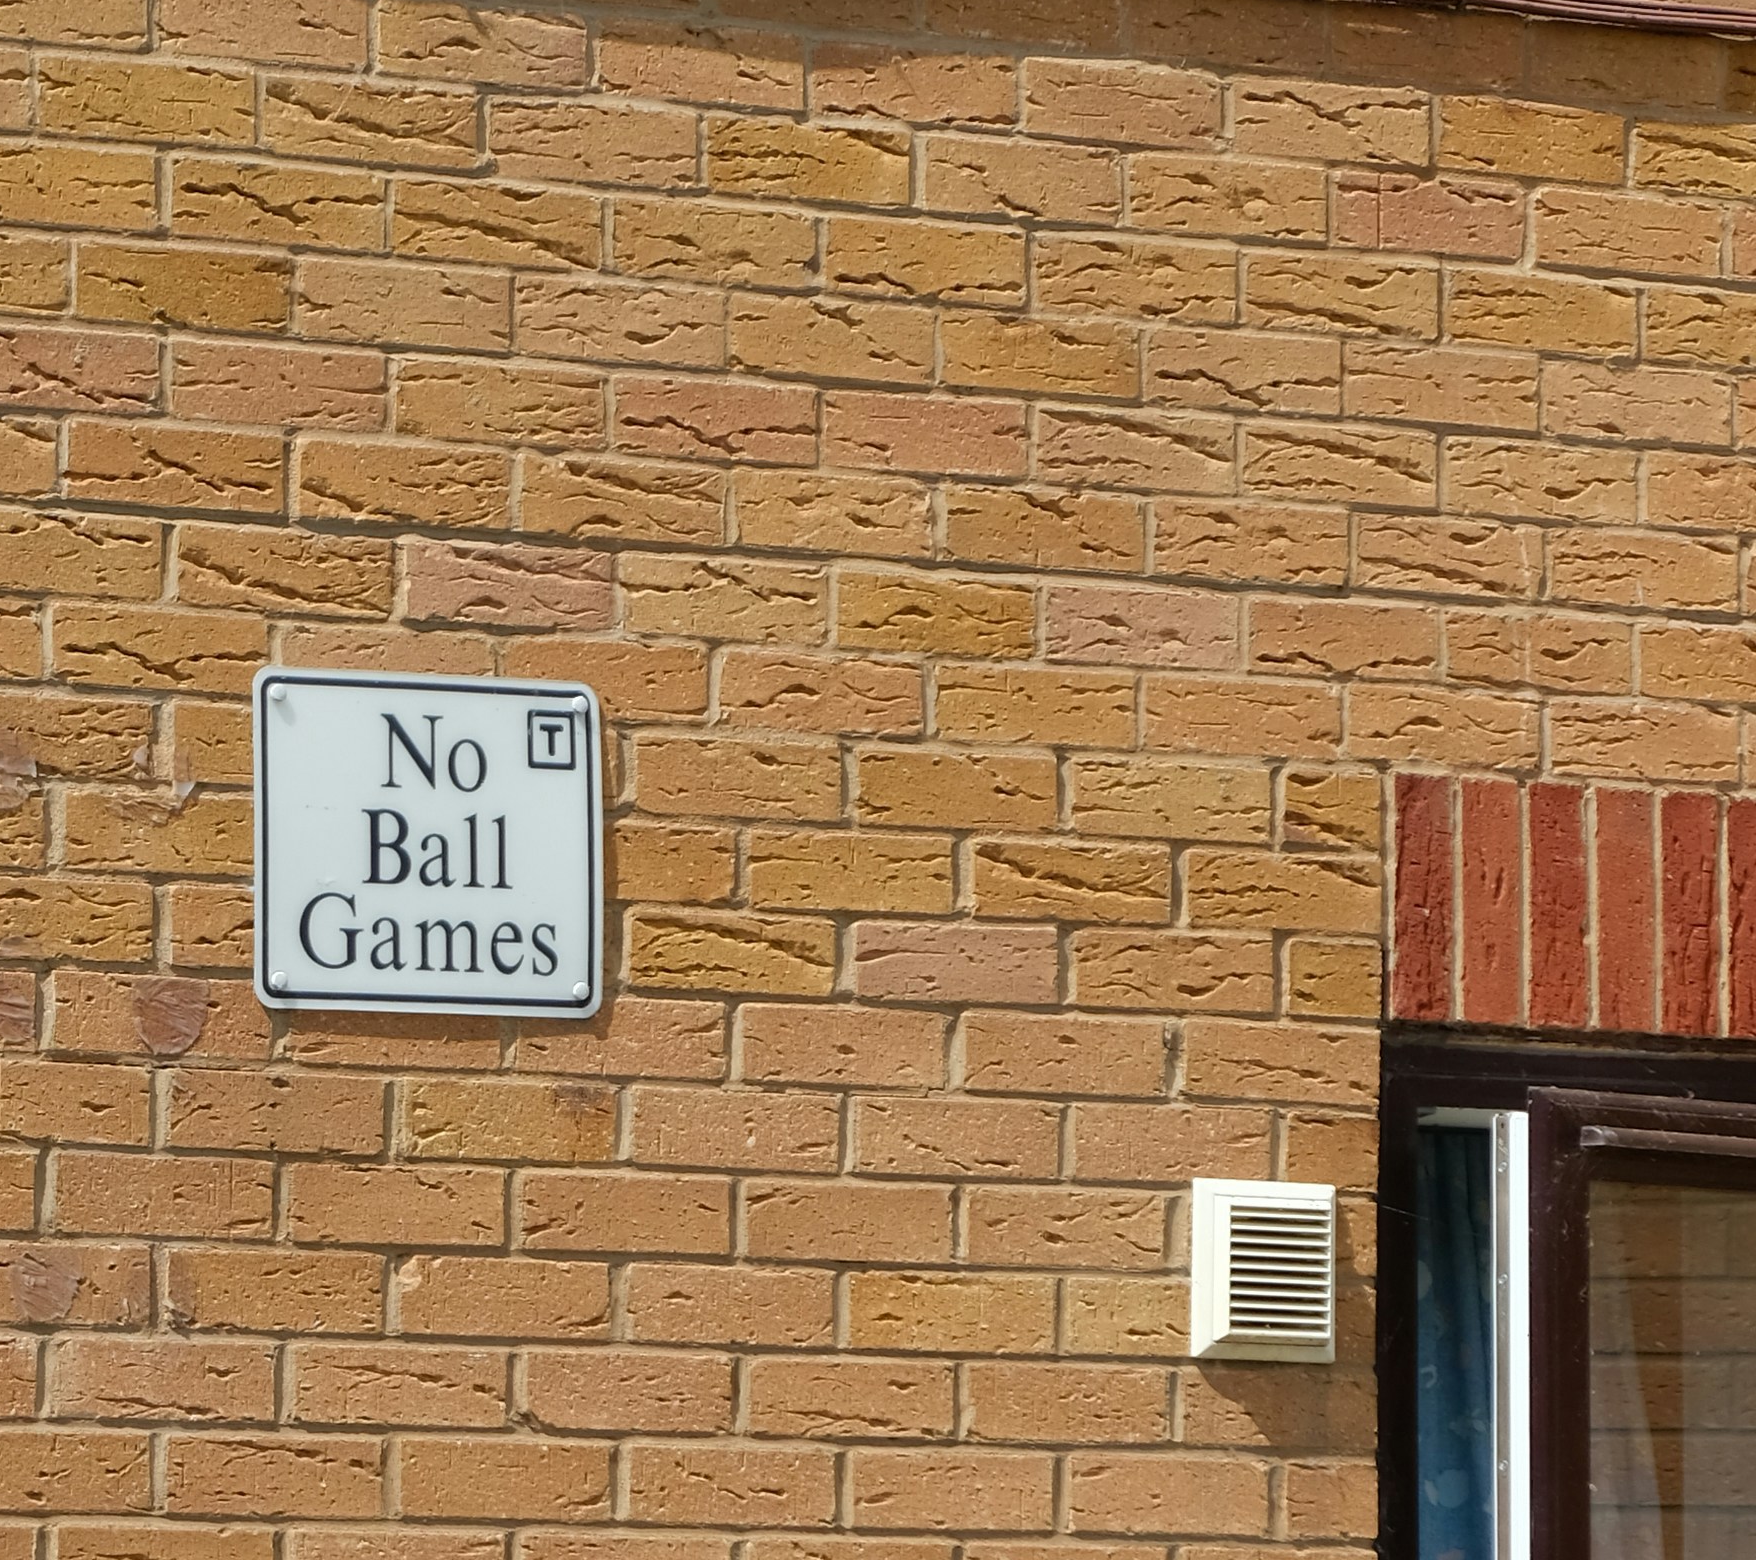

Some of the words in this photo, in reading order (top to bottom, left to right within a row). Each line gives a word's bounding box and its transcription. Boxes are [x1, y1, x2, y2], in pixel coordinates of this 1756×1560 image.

[380, 713, 488, 793] No
[539, 723, 564, 757] T
[361, 808, 513, 890] Ball
[299, 891, 559, 977] Games
